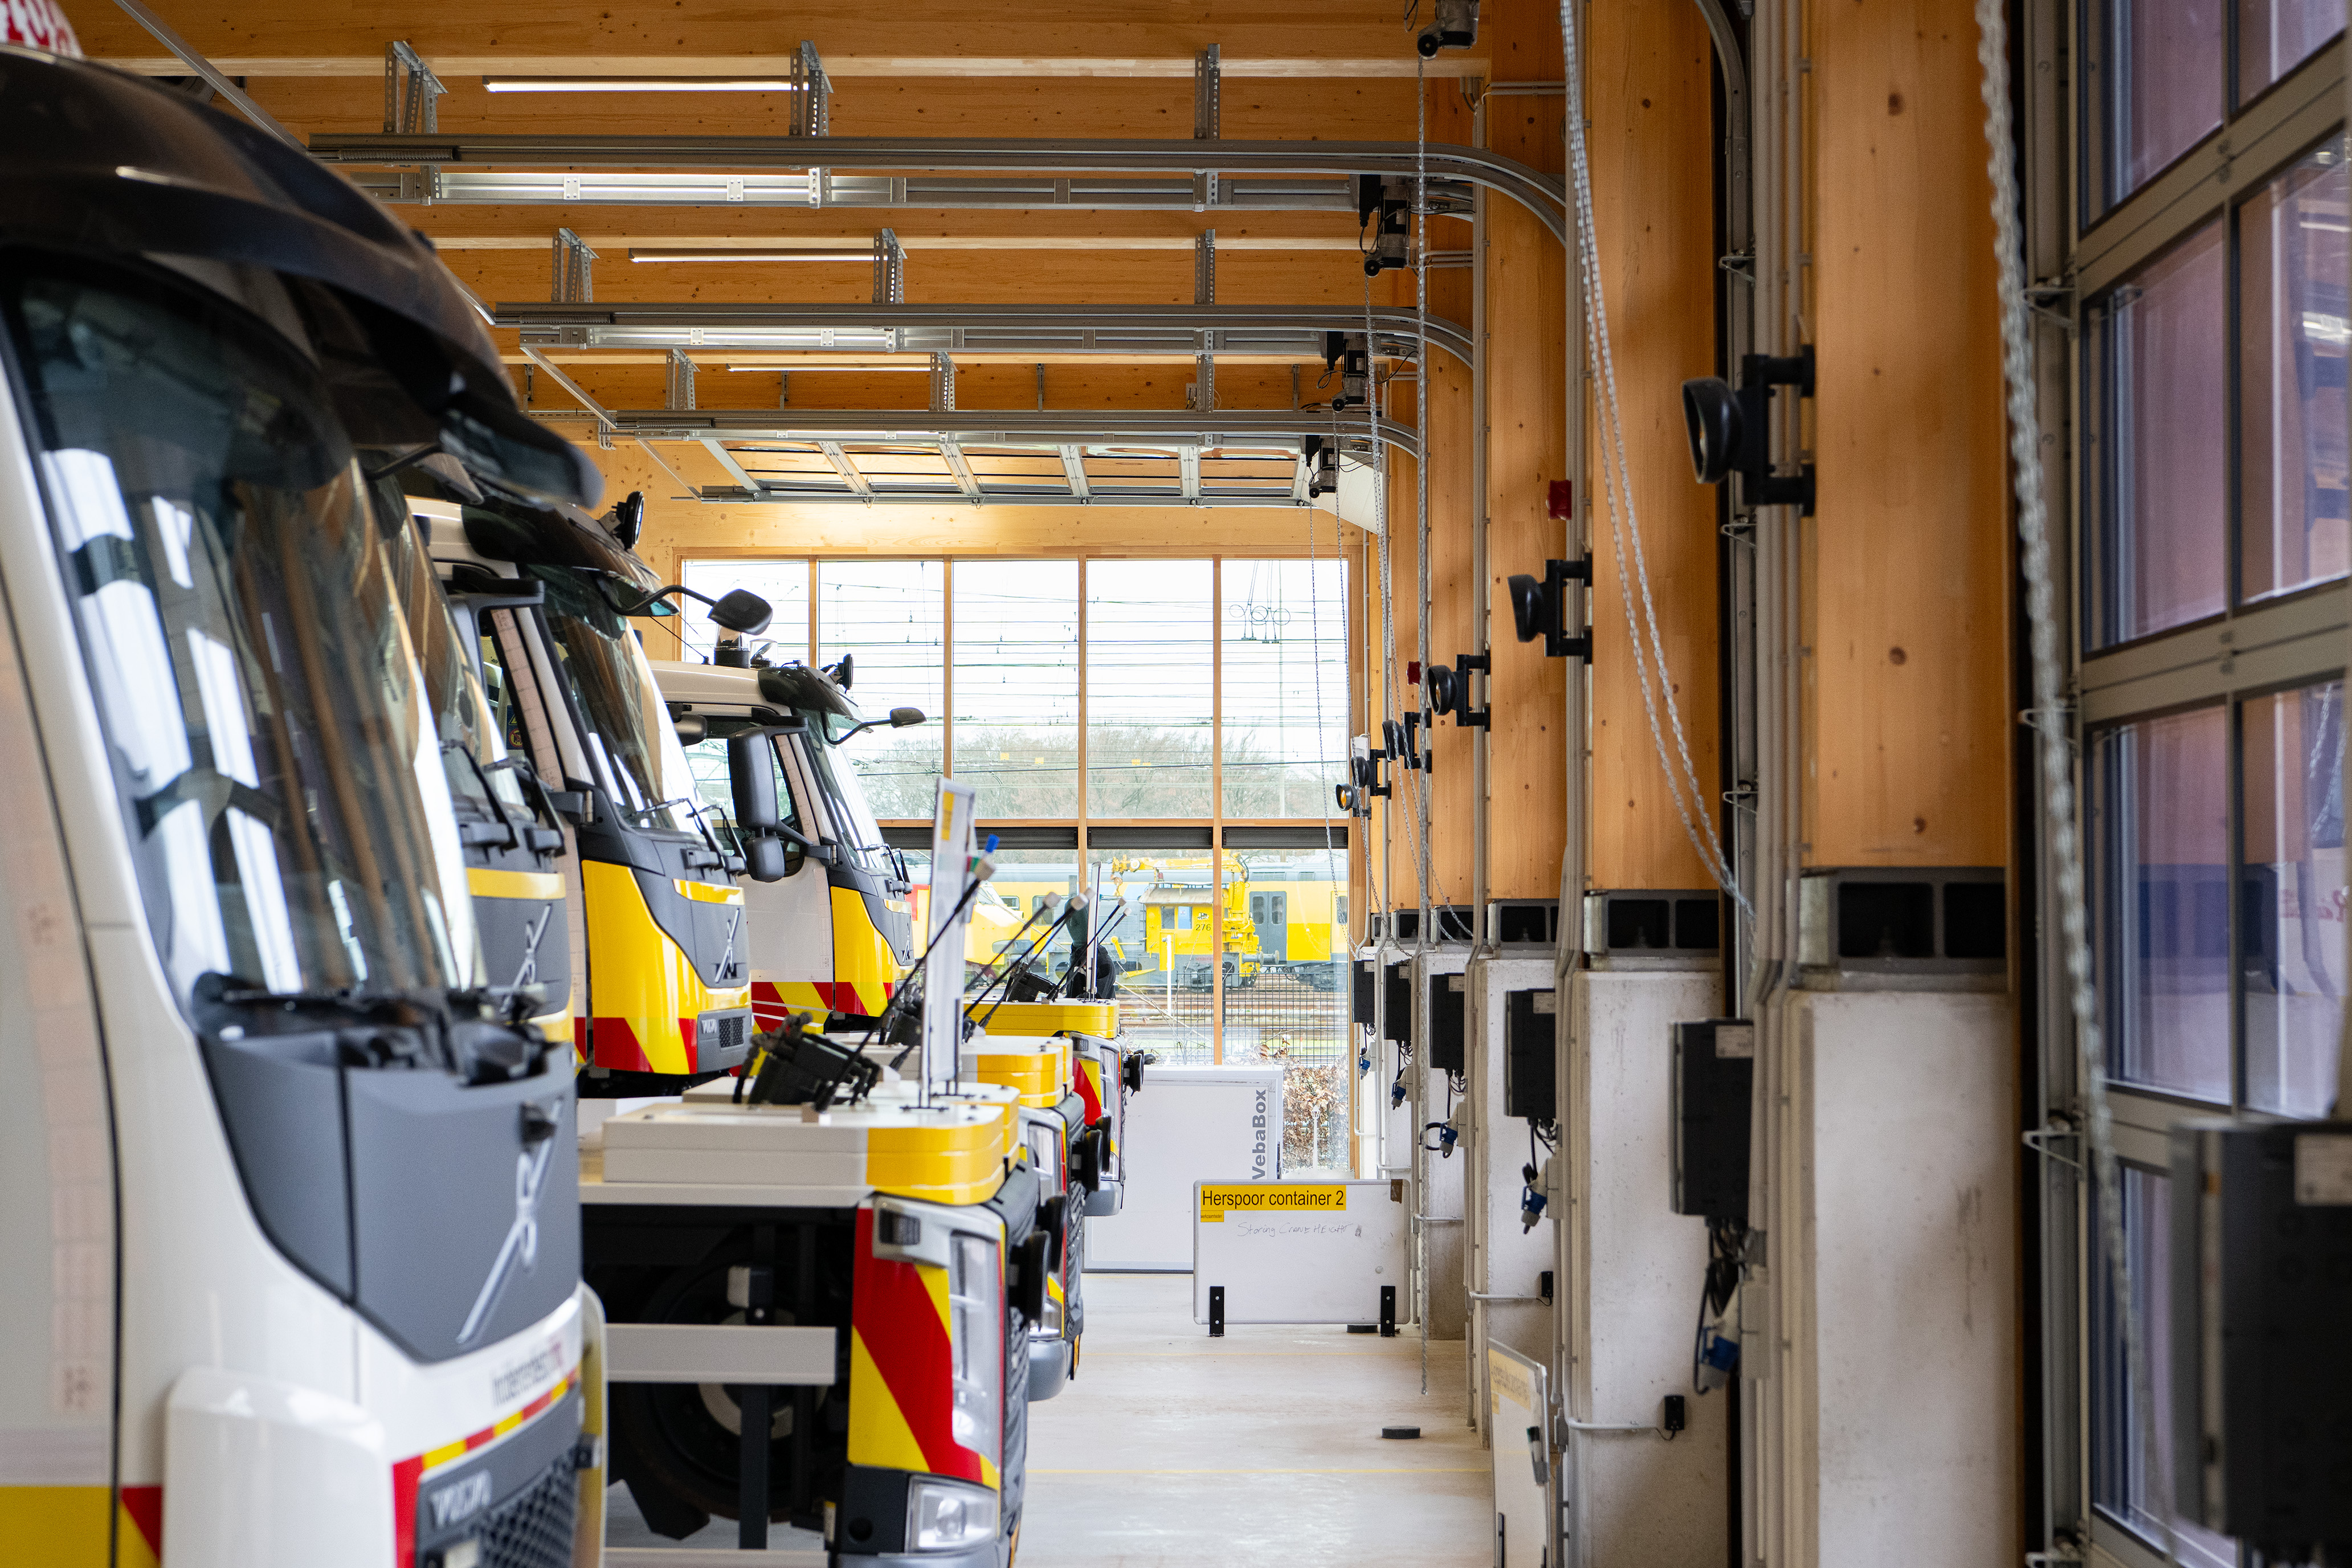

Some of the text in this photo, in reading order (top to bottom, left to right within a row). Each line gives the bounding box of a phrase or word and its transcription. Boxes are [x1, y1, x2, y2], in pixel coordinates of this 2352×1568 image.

[1252, 1089, 1266, 1179] VebaBox
[1203, 1190, 1344, 1209] Herspoor container 2
[1237, 1222, 1275, 1237] Storing
